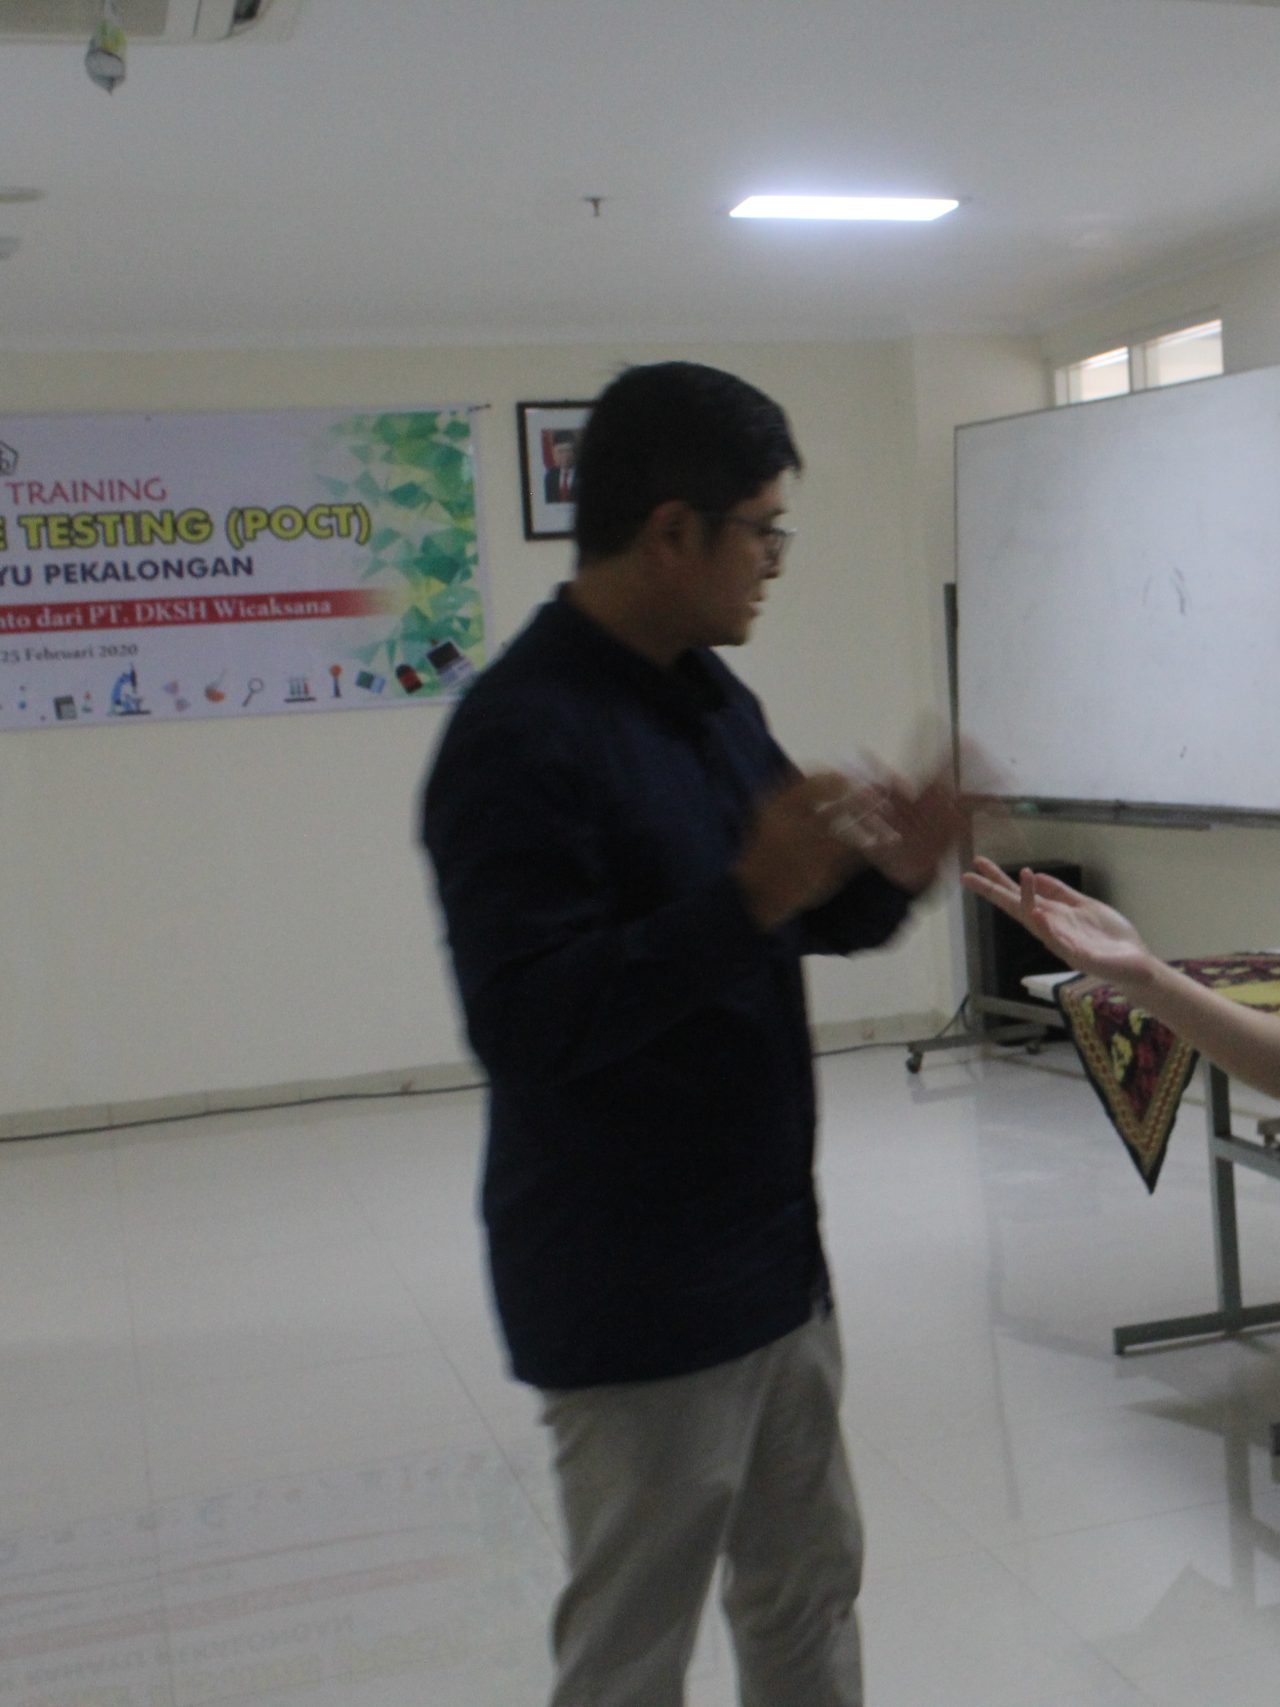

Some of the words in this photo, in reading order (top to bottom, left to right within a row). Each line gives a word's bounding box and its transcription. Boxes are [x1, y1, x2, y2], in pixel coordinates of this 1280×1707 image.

[5, 475, 168, 505] TRAINING
[18, 506, 213, 551] TESTING
[226, 502, 371, 550] (POCT)
[44, 556, 253, 586] PEKALONGAN
[36, 606, 83, 628] dari
[88, 604, 130, 625] PT.
[135, 600, 208, 623] DKSH
[213, 597, 332, 619] Wicaksana
[25, 645, 94, 661] Februari
[99, 644, 138, 658] 2020
